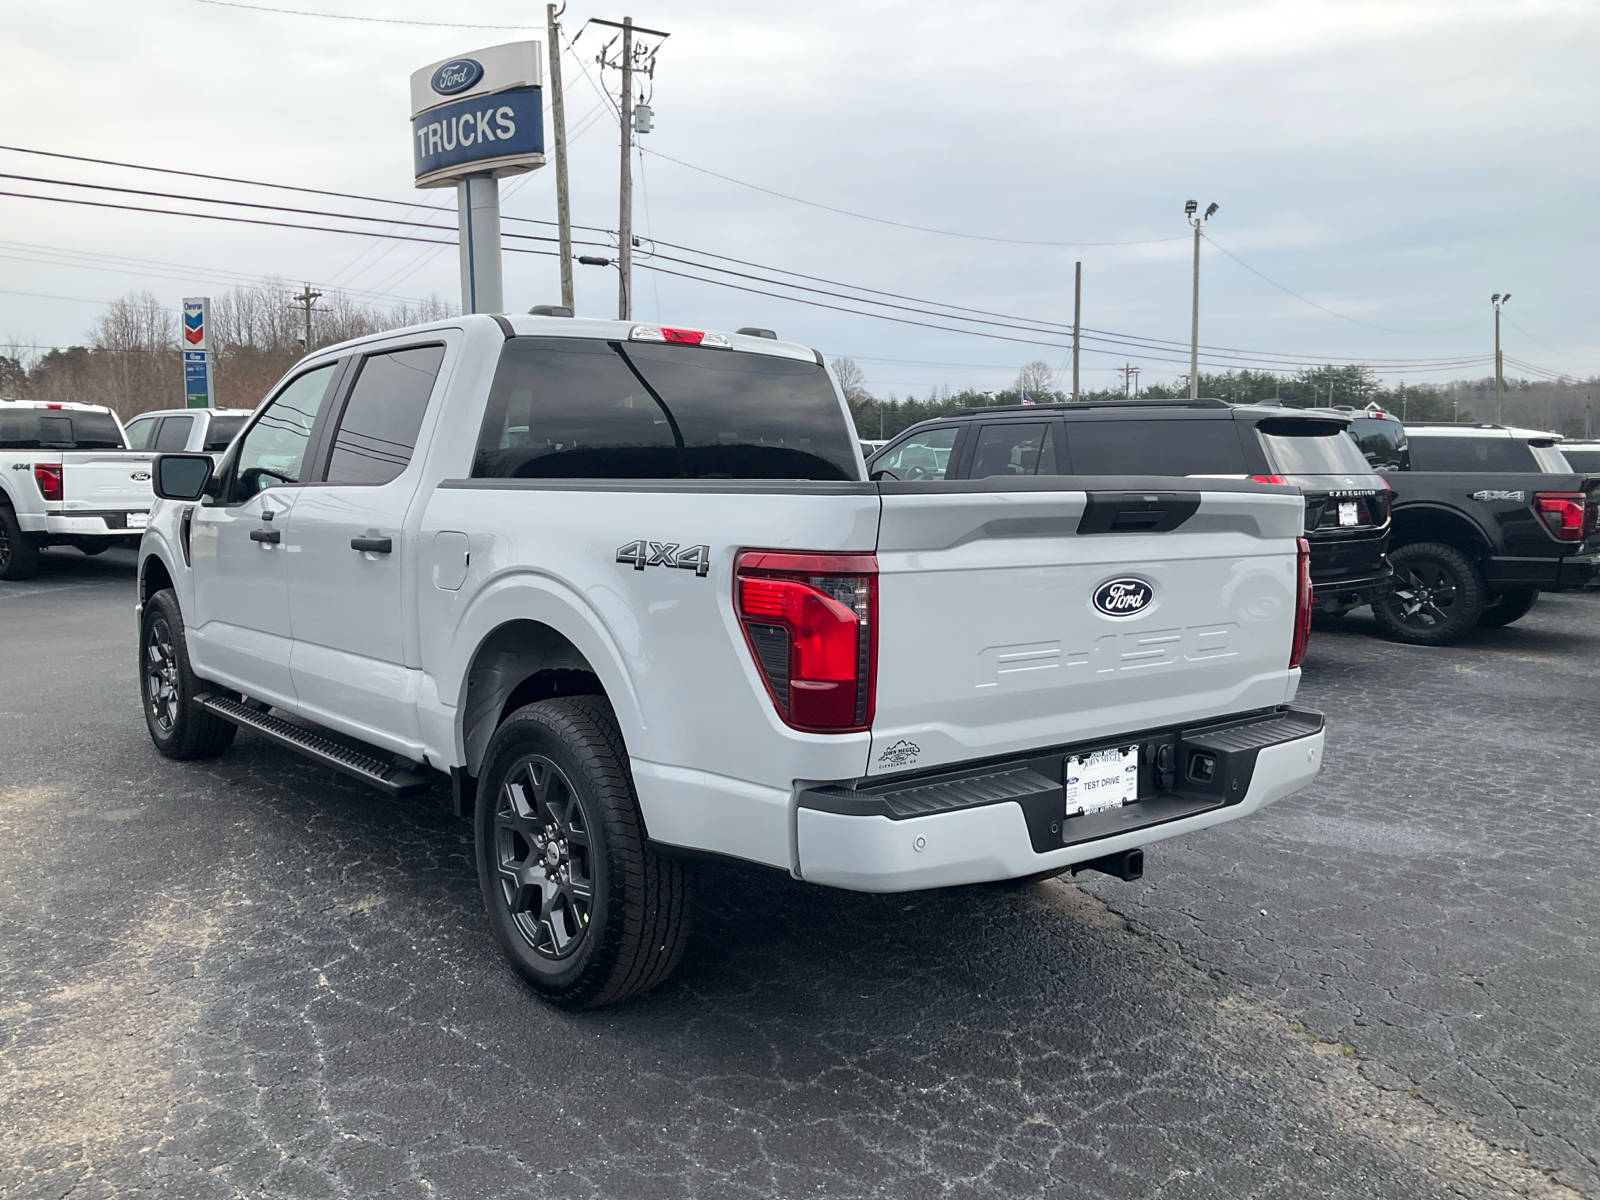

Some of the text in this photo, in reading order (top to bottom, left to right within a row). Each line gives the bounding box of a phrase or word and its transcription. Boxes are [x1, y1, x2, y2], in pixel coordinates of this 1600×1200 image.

[440, 65, 467, 88] Ford
[417, 106, 516, 158] TRUCKS
[184, 302, 203, 310] Chevron
[1105, 583, 1143, 610] Ford
[1084, 780, 1100, 790] TEST
[1101, 775, 1120, 787] DRIVE
